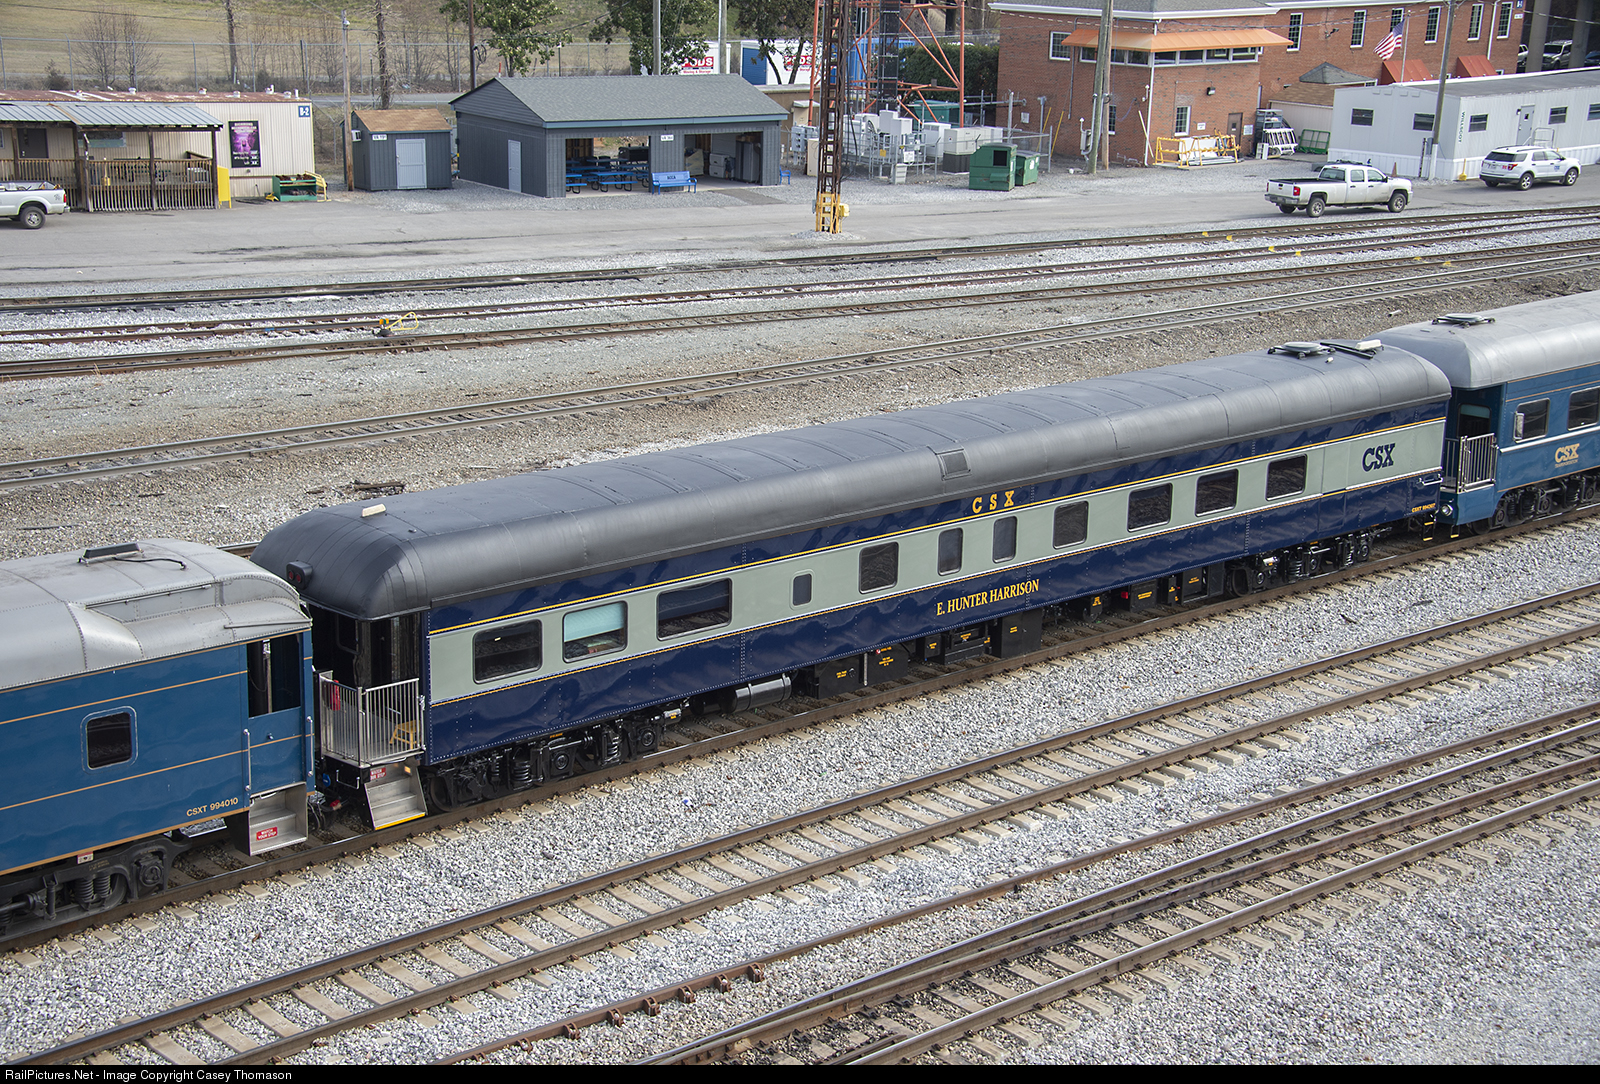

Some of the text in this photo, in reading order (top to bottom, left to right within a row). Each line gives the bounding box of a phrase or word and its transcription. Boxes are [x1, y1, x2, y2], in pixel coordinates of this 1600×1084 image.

[299, 106, 310, 116] B-2
[1362, 442, 1396, 472] CSX
[1555, 443, 1580, 463] CSX
[936, 579, 1040, 616] E. HUNTER HARRISON
[186, 797, 239, 817] CSXT 994010
